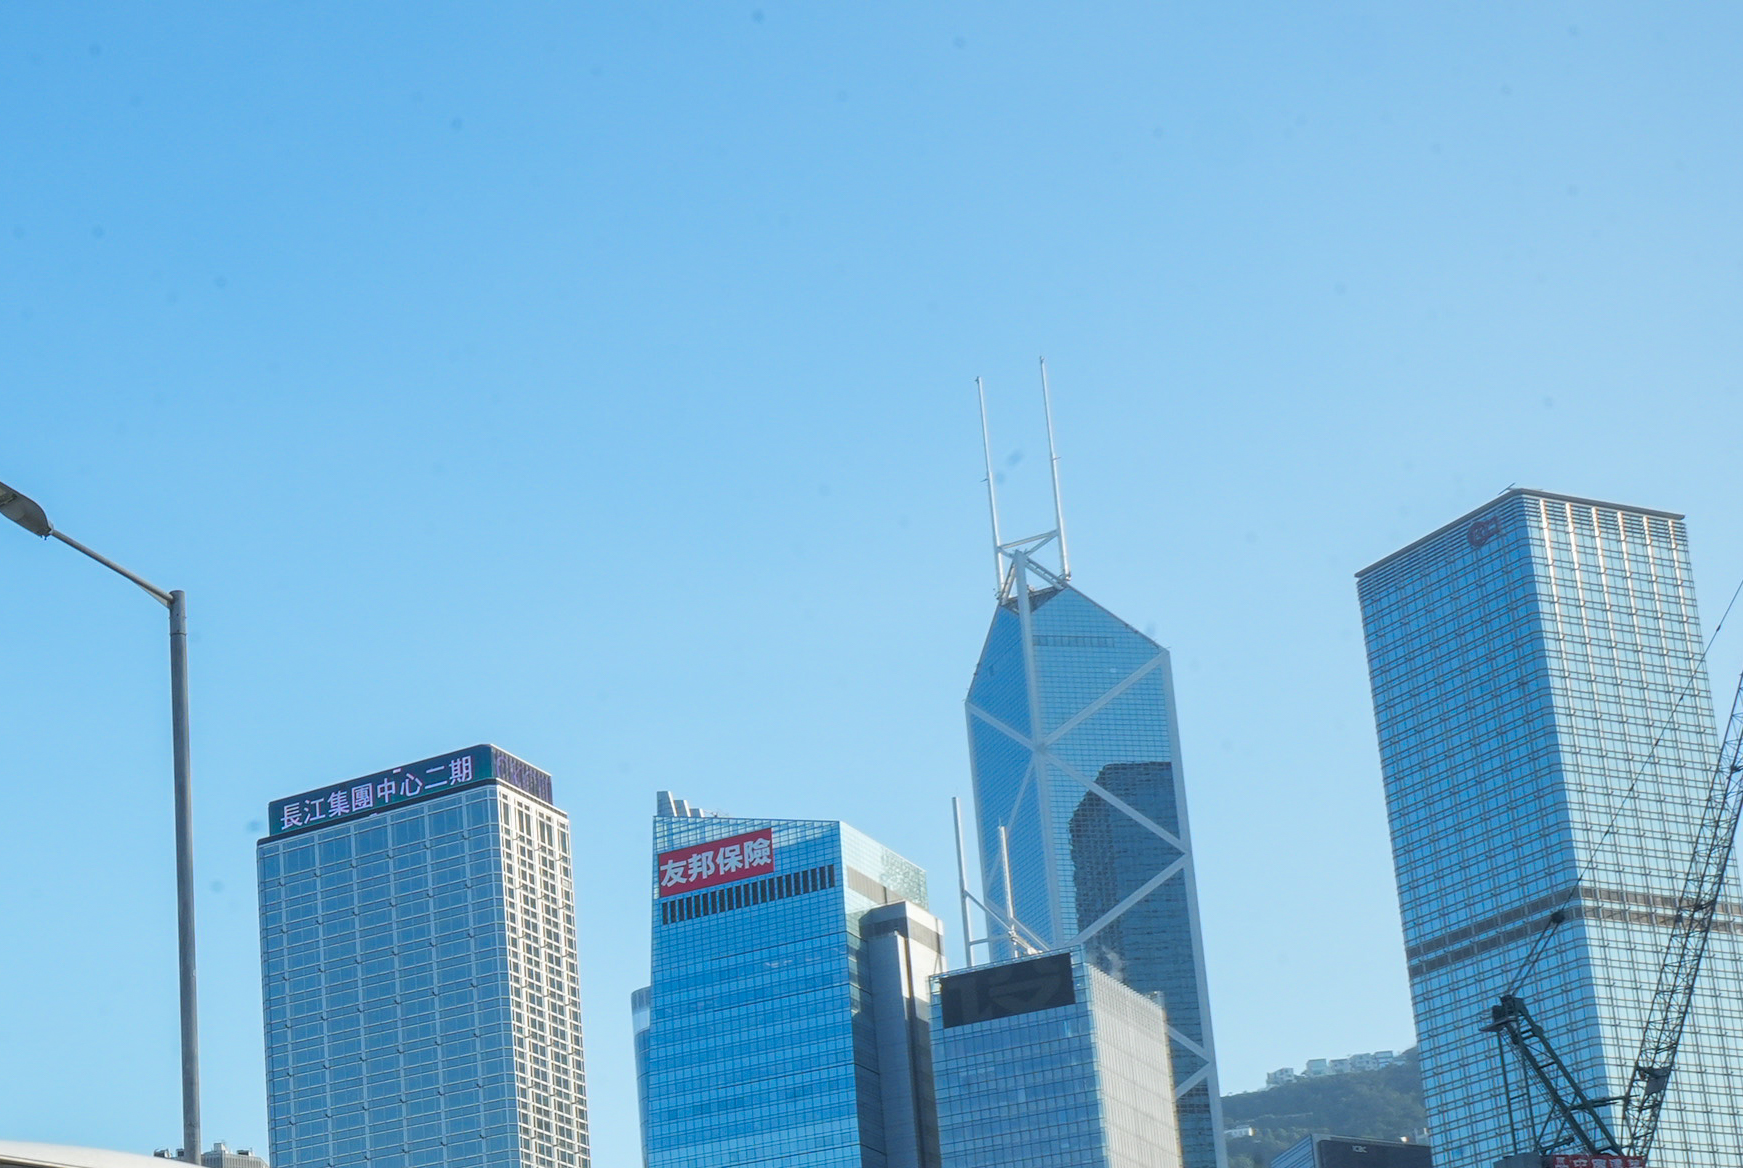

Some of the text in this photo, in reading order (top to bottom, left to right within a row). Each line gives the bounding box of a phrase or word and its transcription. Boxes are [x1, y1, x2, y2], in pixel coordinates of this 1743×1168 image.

[280, 755, 473, 831] 長江集團中心二期
[660, 837, 772, 887] 友邦保險
